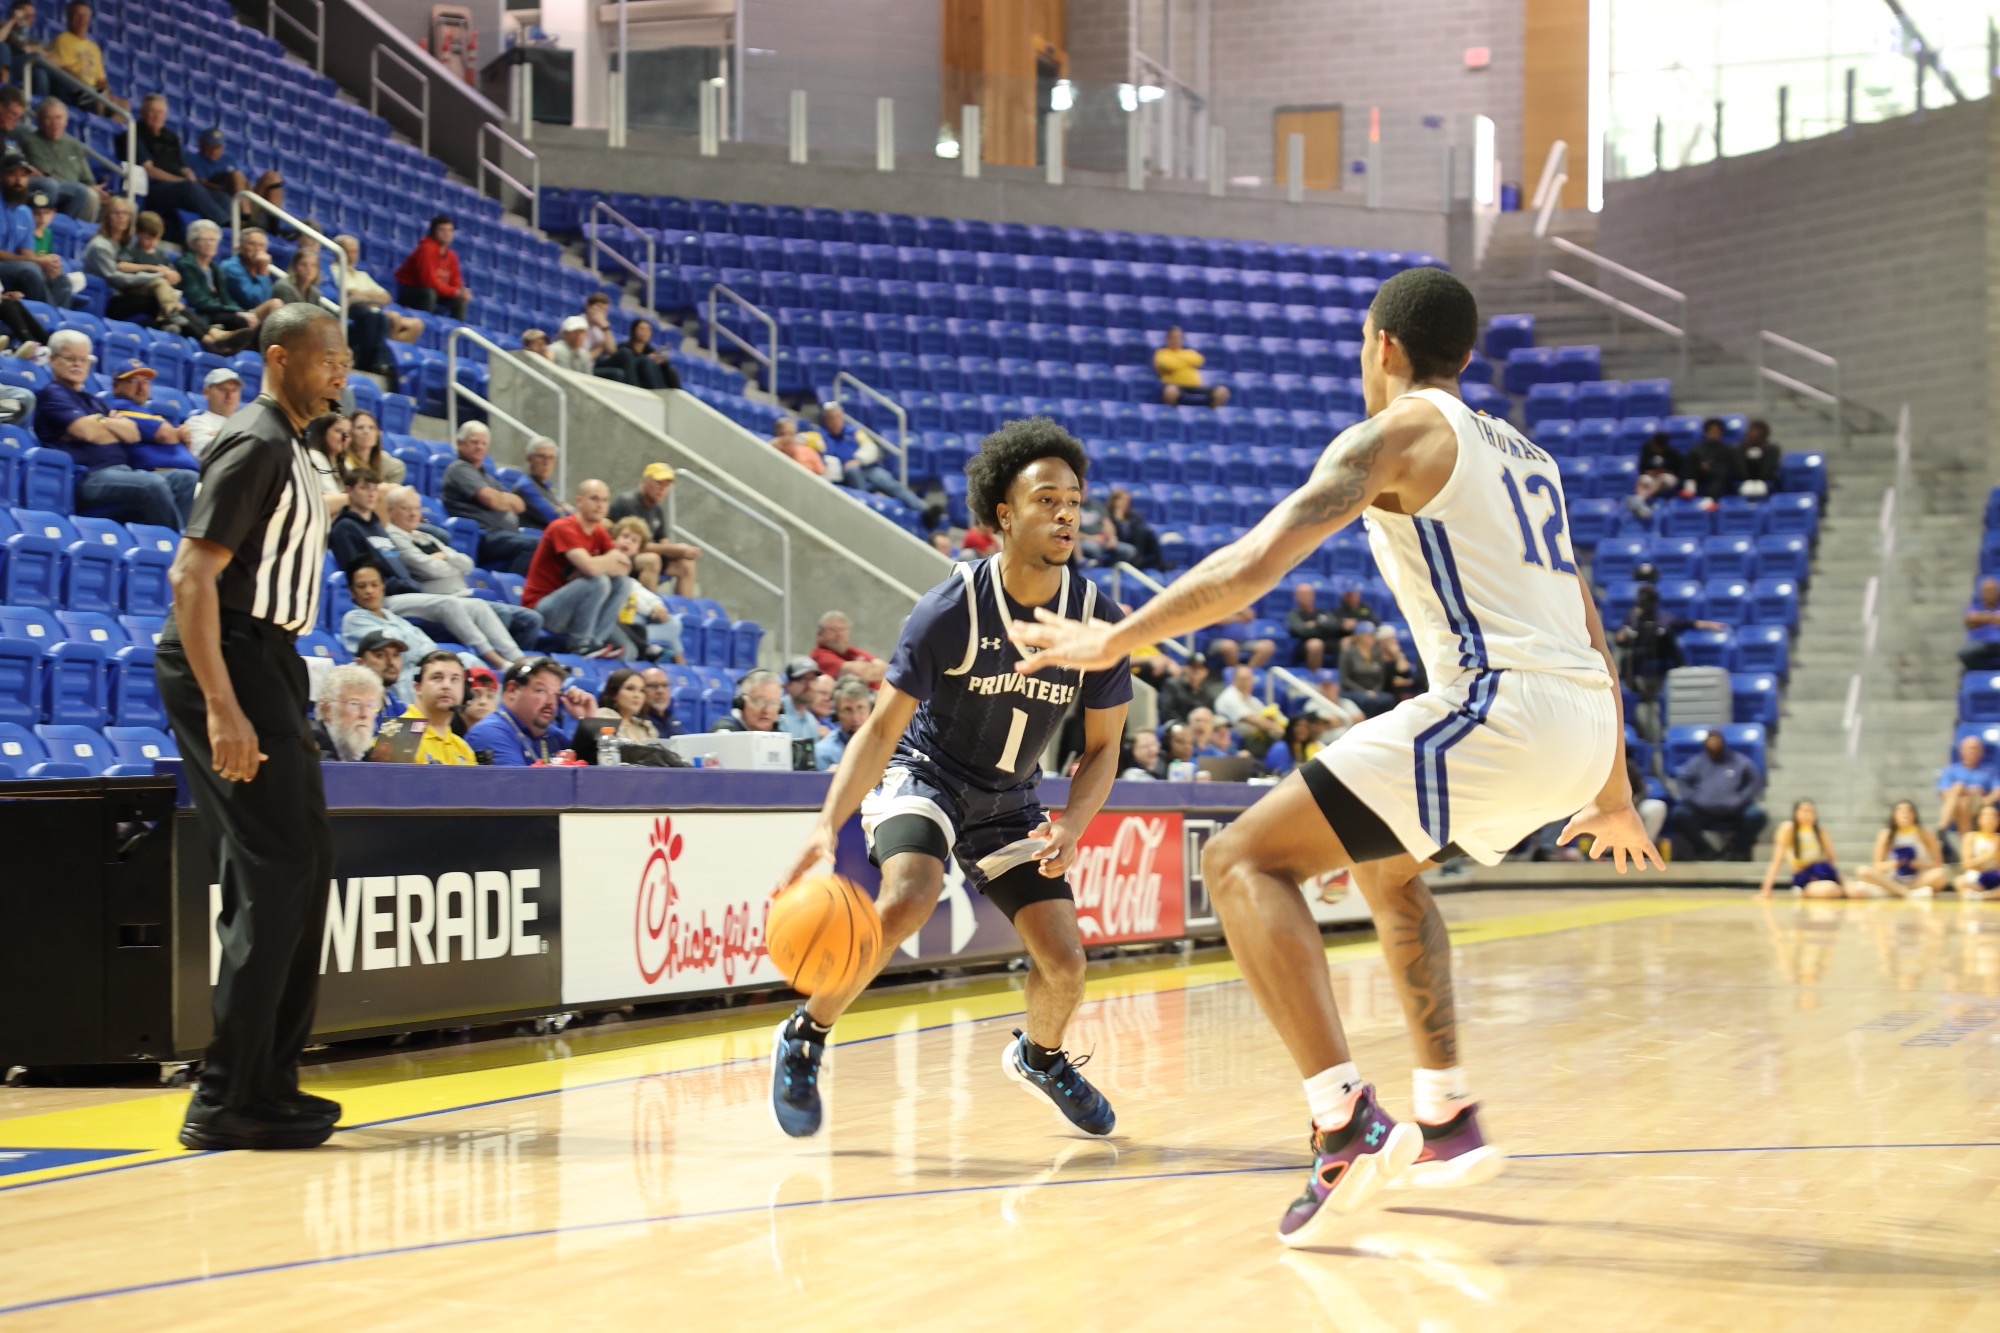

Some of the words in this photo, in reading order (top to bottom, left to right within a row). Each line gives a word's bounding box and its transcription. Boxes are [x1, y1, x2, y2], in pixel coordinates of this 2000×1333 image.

[1499, 462, 1578, 578] 12
[995, 707, 1029, 774] 1
[208, 868, 541, 986] WERADE
[1070, 815, 1168, 937] ca-Cola
